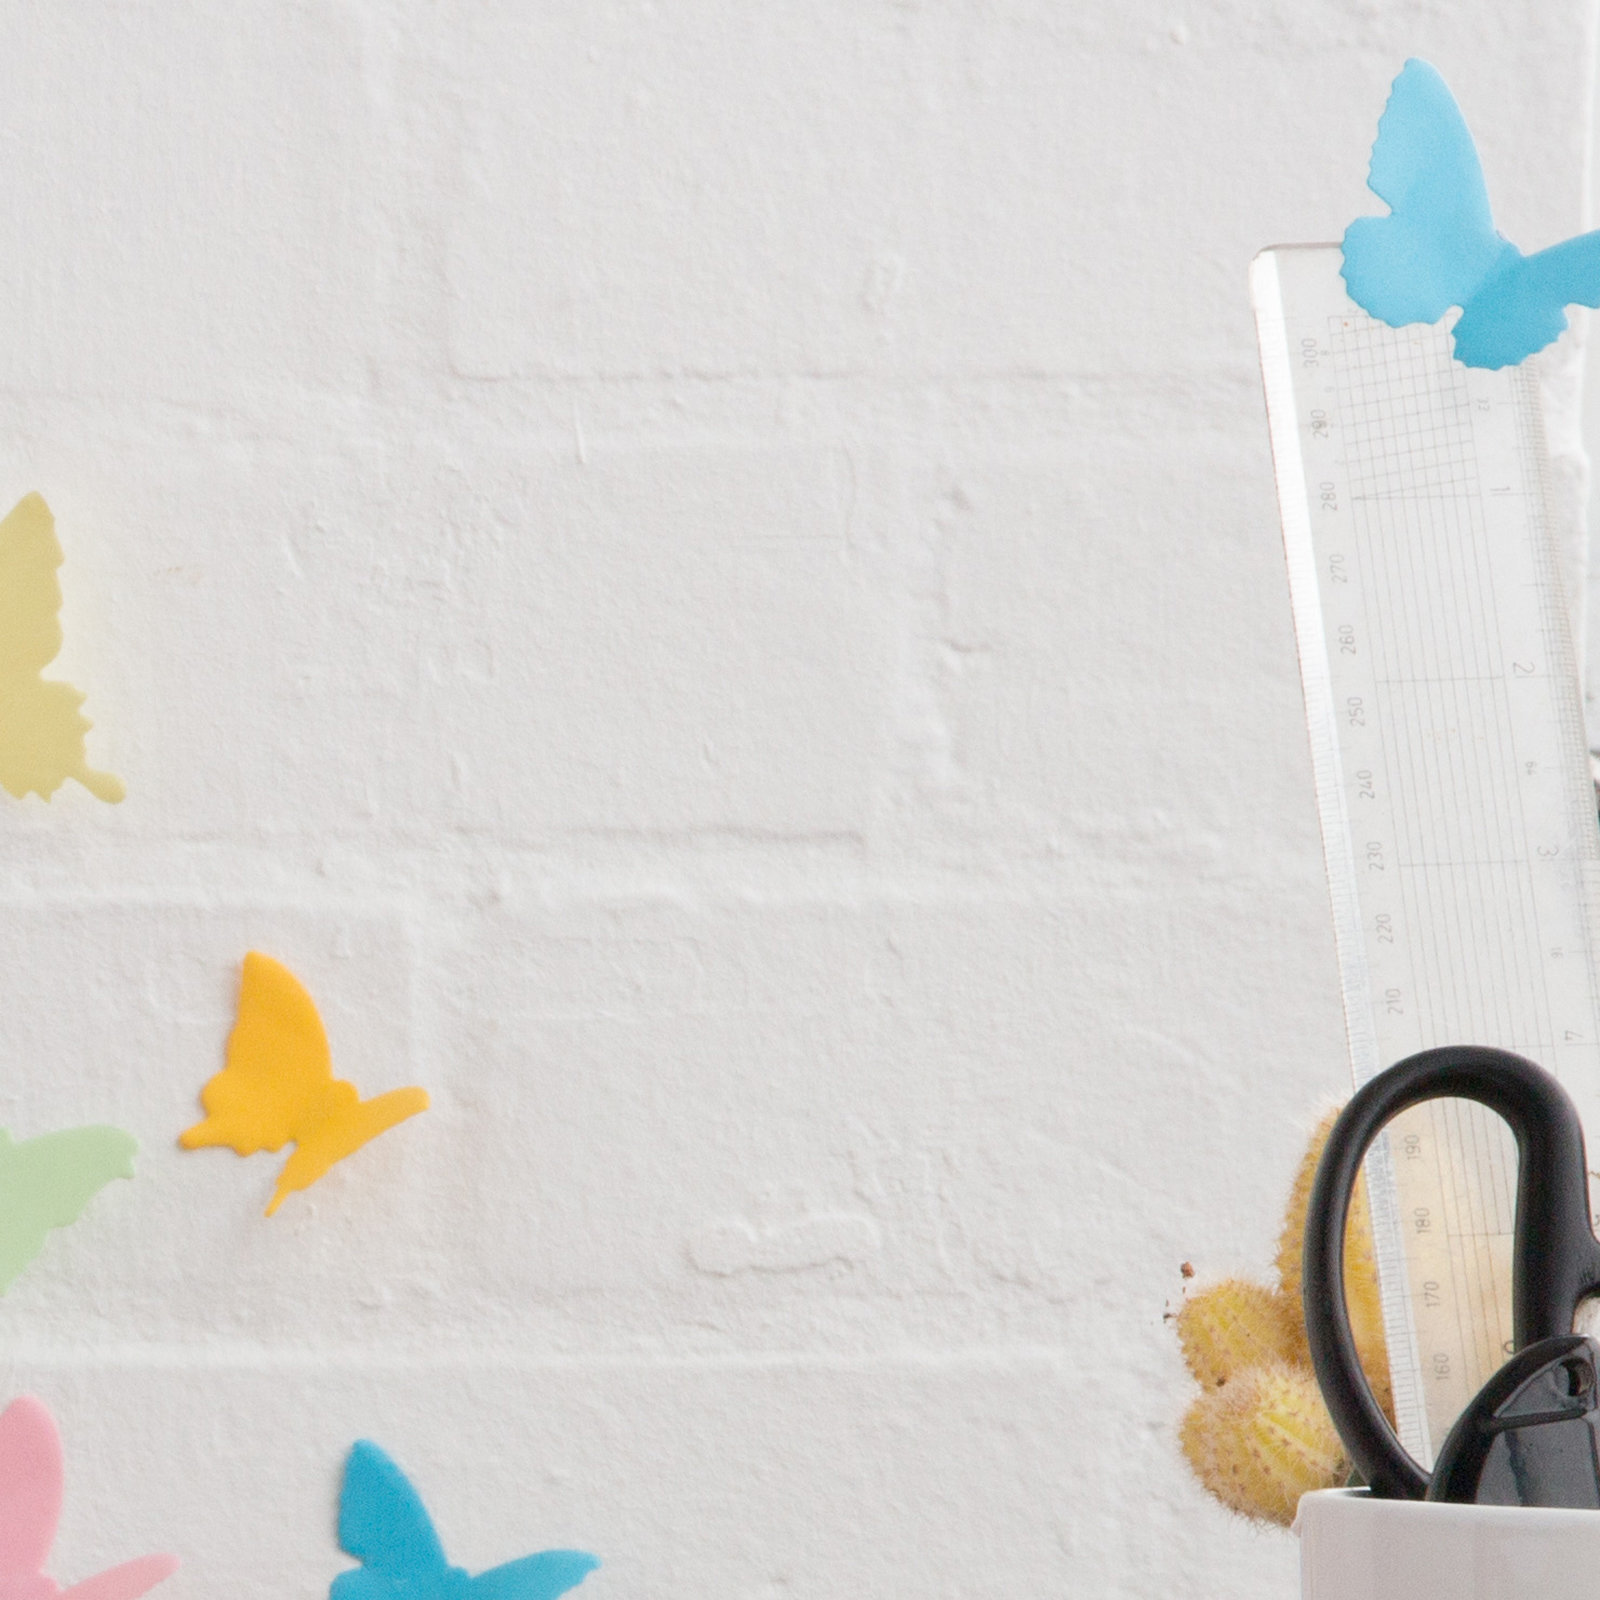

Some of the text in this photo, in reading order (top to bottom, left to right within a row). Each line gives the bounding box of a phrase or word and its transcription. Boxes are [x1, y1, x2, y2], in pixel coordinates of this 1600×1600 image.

[1300, 337, 1319, 368] 300
[1311, 408, 1329, 439] 290
[1321, 481, 1338, 512] 280
[1330, 553, 1348, 584] 270
[1339, 624, 1357, 655] 260
[1349, 696, 1366, 728] 250
[1358, 768, 1376, 800] 240
[1367, 840, 1384, 872] 230
[1377, 913, 1394, 944] 220
[1386, 987, 1404, 1016] 210
[1405, 1133, 1421, 1161] 190
[1415, 1206, 1432, 1235] 180
[1426, 1280, 1441, 1308] 170
[1434, 1352, 1450, 1381] 160
